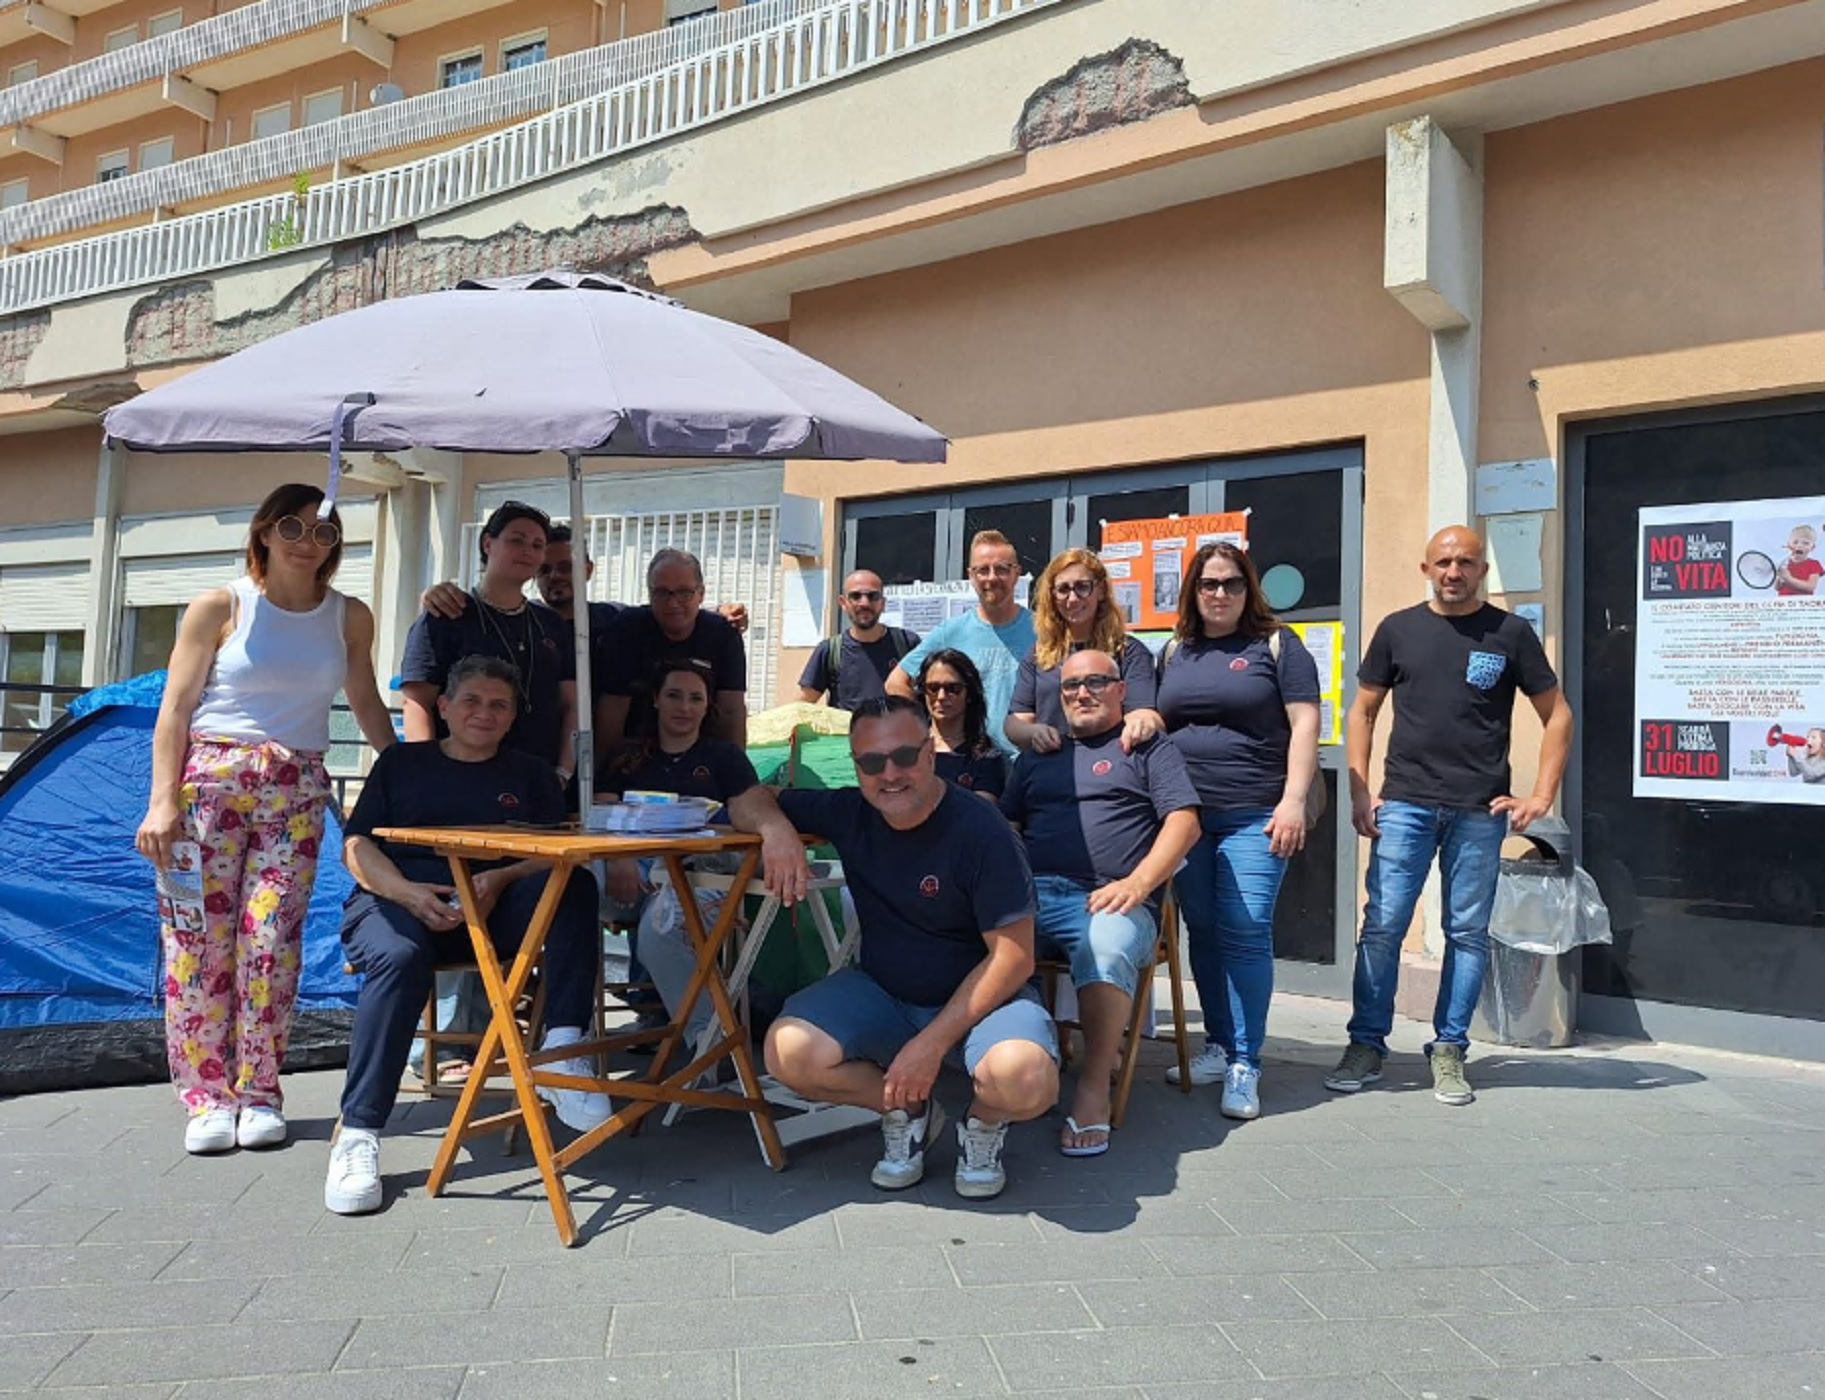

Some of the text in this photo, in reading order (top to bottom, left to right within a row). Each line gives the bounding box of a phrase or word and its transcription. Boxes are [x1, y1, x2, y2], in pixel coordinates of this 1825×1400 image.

[1649, 535, 1684, 563] NO
[1675, 563, 1728, 590] VITA
[1645, 723, 1673, 751] 31
[1645, 752, 1719, 776] LUGLIO
